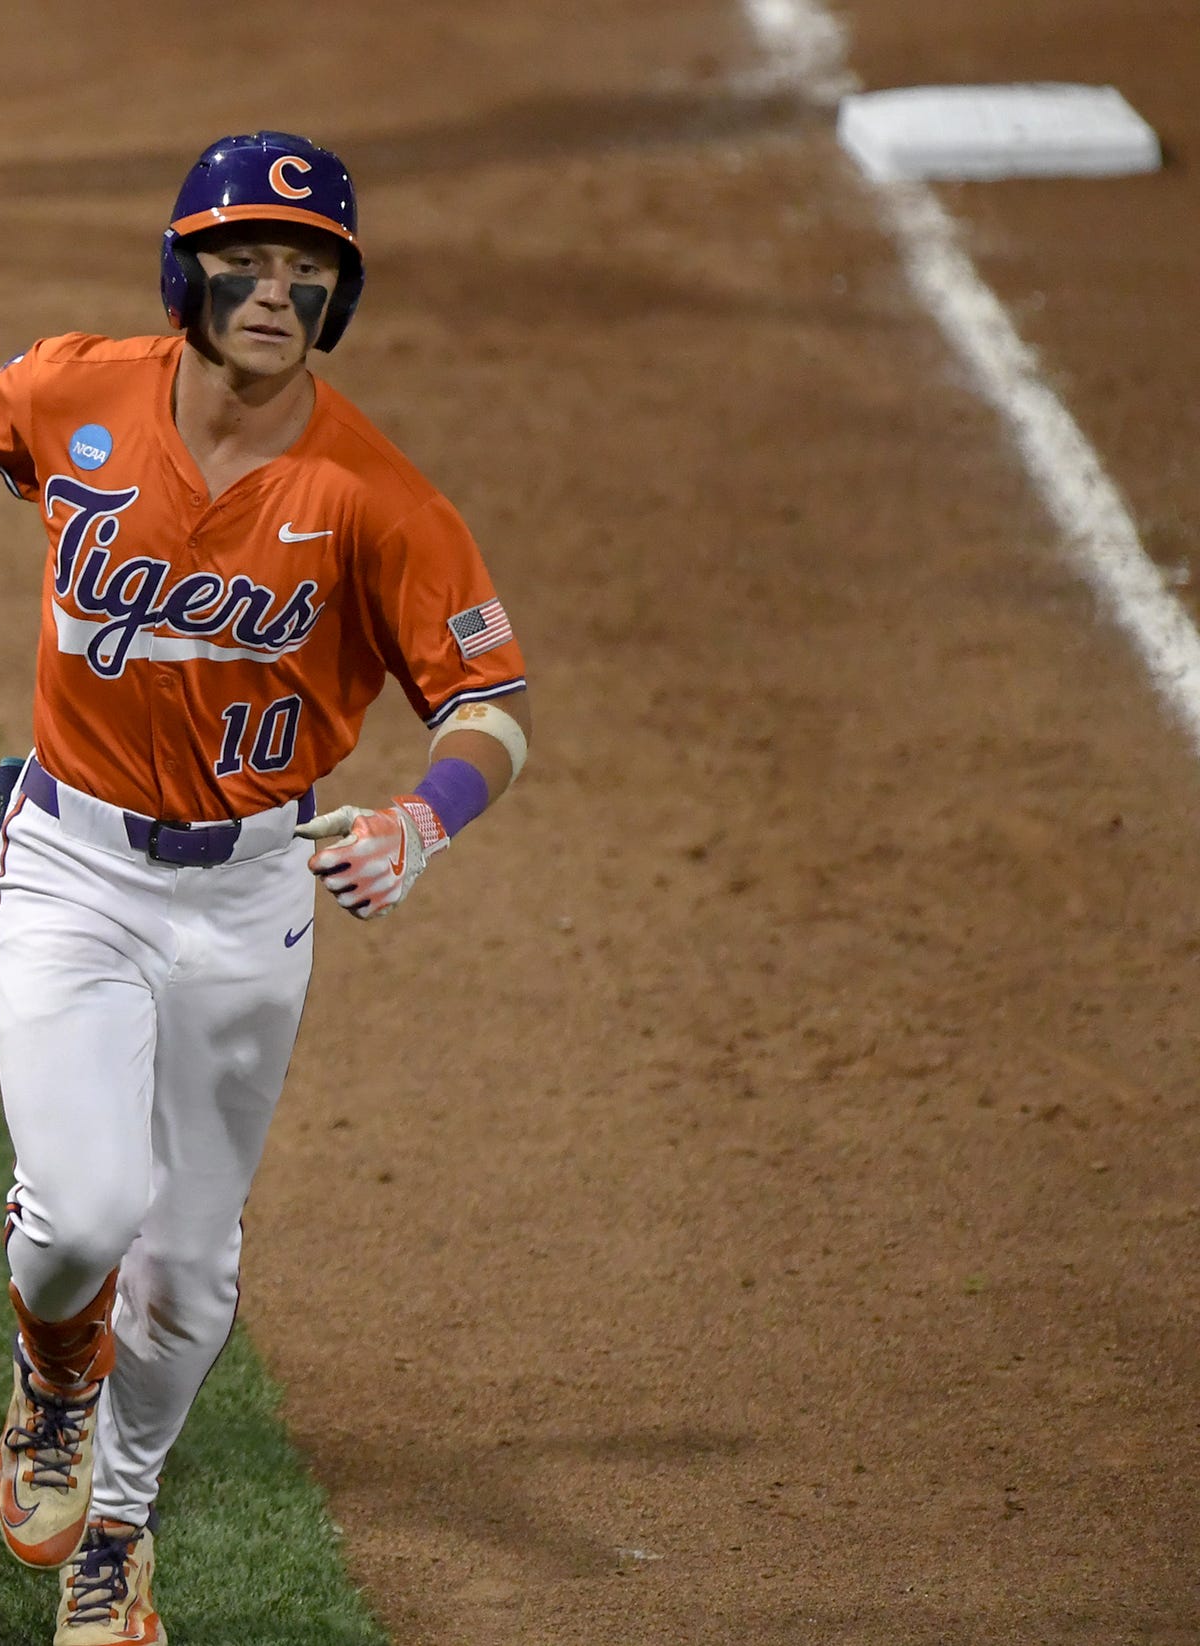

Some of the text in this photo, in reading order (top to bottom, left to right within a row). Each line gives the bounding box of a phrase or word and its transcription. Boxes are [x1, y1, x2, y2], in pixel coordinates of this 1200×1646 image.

[268, 155, 312, 200] C
[73, 441, 107, 464] NCAA
[45, 474, 326, 680] Tigers
[214, 693, 303, 779] 10
